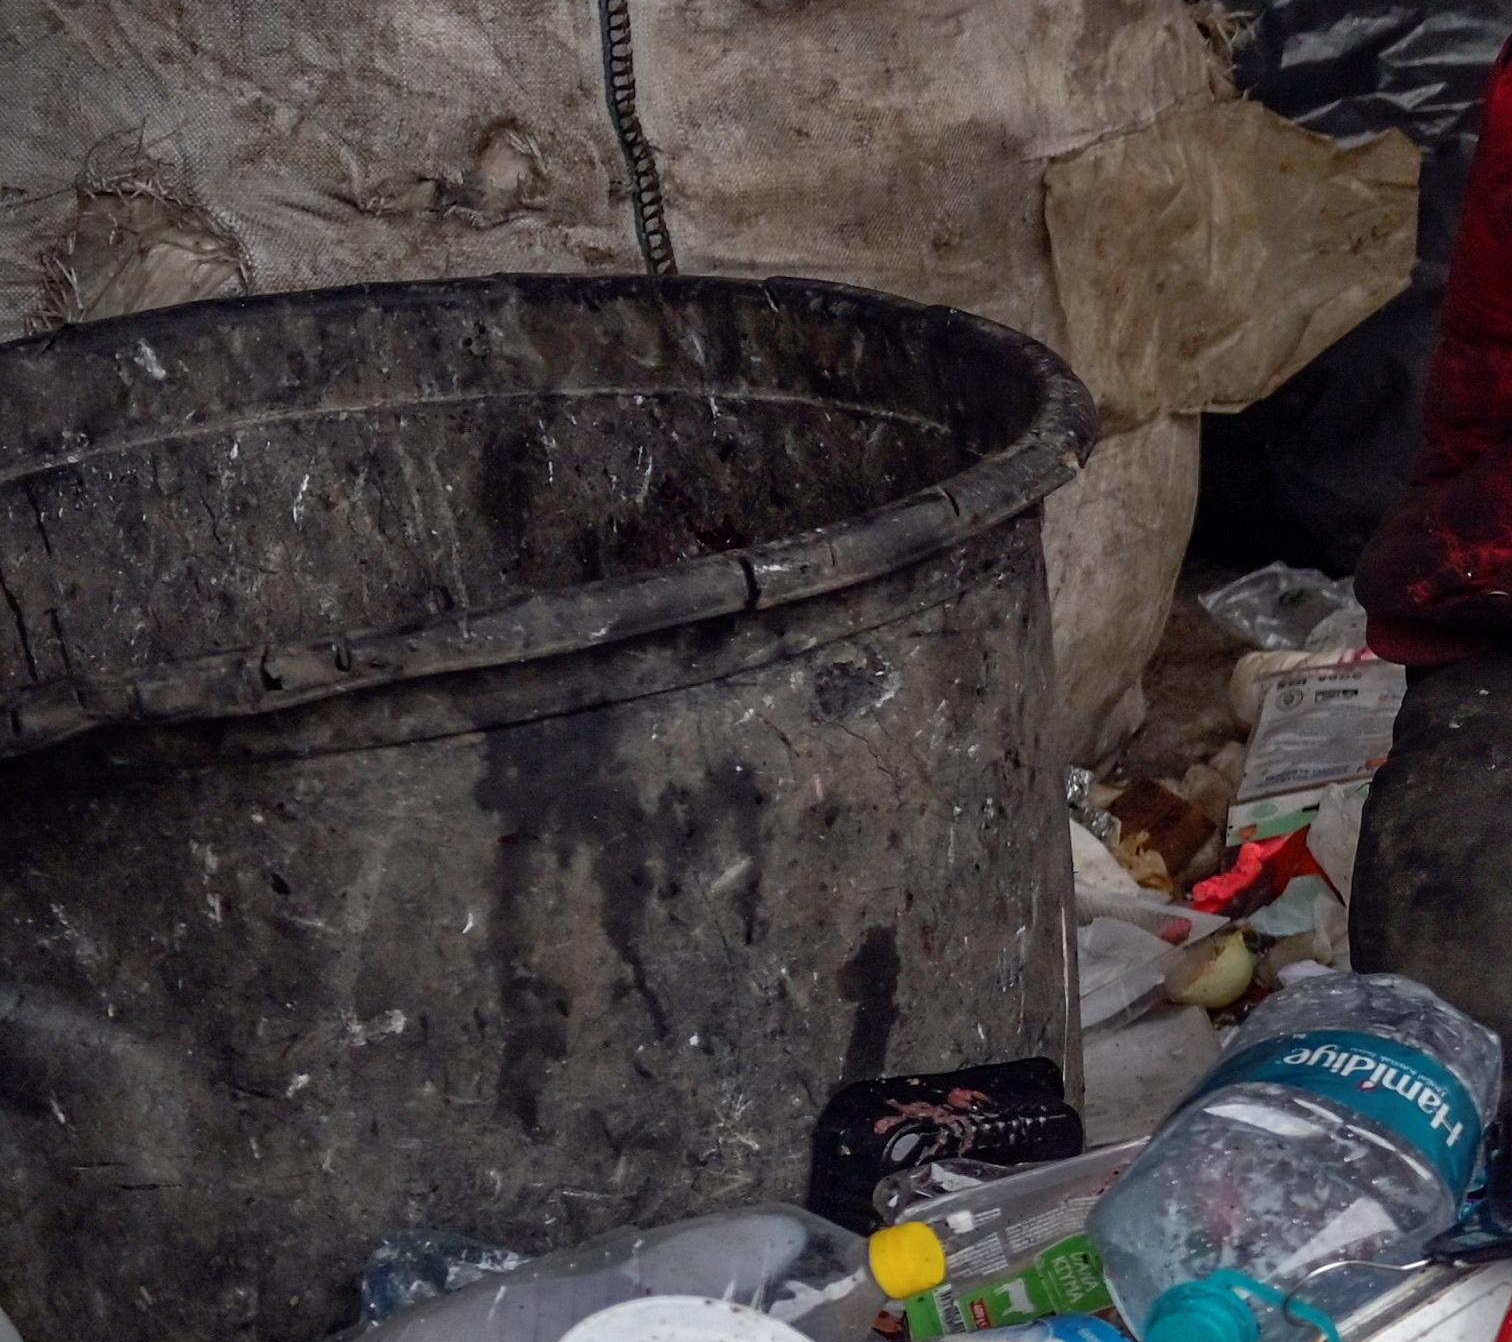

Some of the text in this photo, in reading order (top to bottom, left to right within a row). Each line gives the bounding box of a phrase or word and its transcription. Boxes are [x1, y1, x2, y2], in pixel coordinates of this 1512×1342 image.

[1282, 1043, 1466, 1148] Hamidiye
[1053, 1253, 1086, 1305] KIYMA
[1076, 1251, 1099, 1293] DANA
